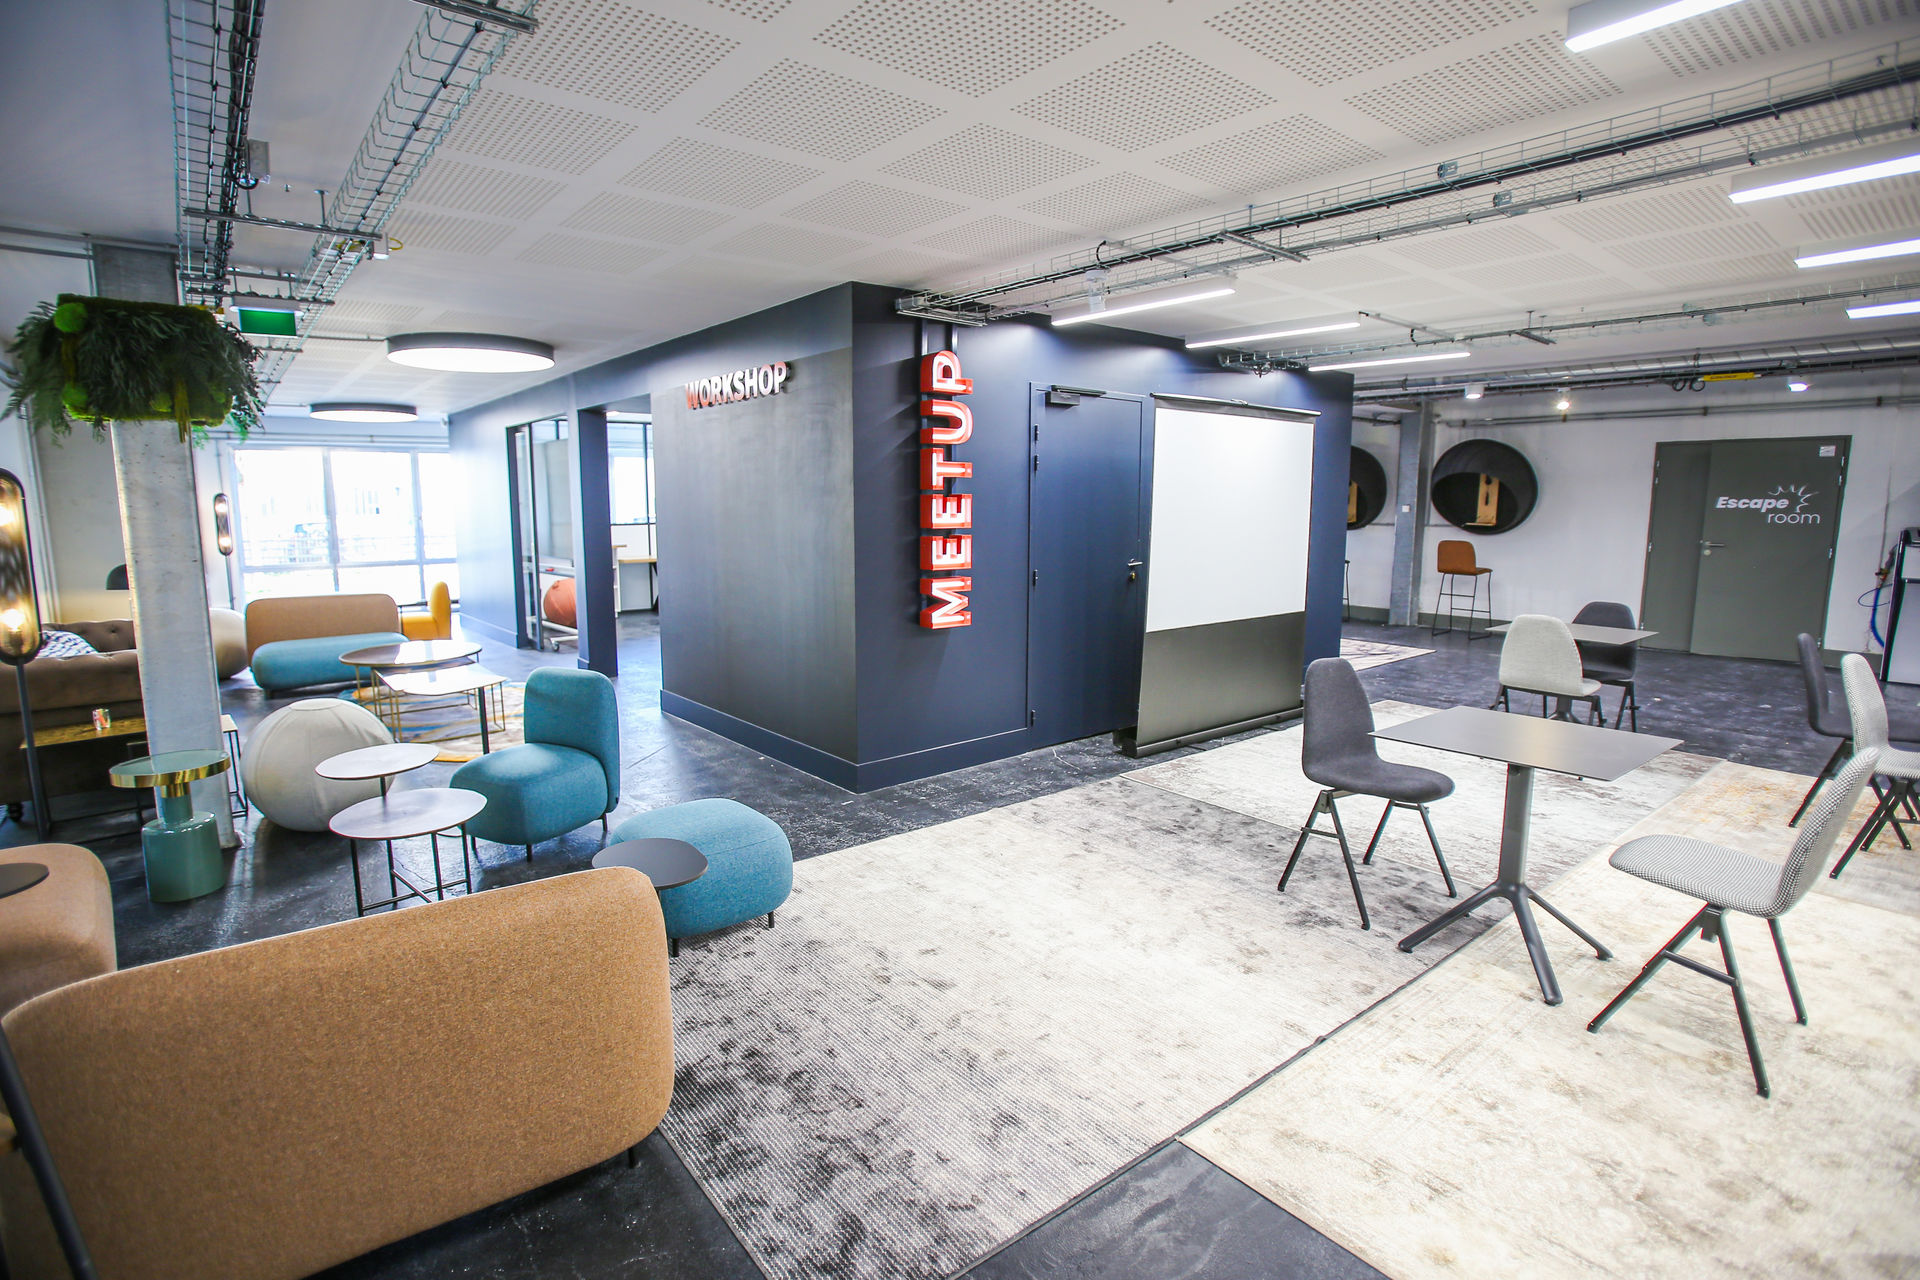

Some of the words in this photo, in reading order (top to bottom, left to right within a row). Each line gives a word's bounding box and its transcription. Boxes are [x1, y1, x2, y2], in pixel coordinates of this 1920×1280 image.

[685, 361, 788, 409] WORKSHOP
[920, 350, 973, 629] MEETUP
[1715, 496, 1790, 513] Escape
[1767, 513, 1821, 524] room
